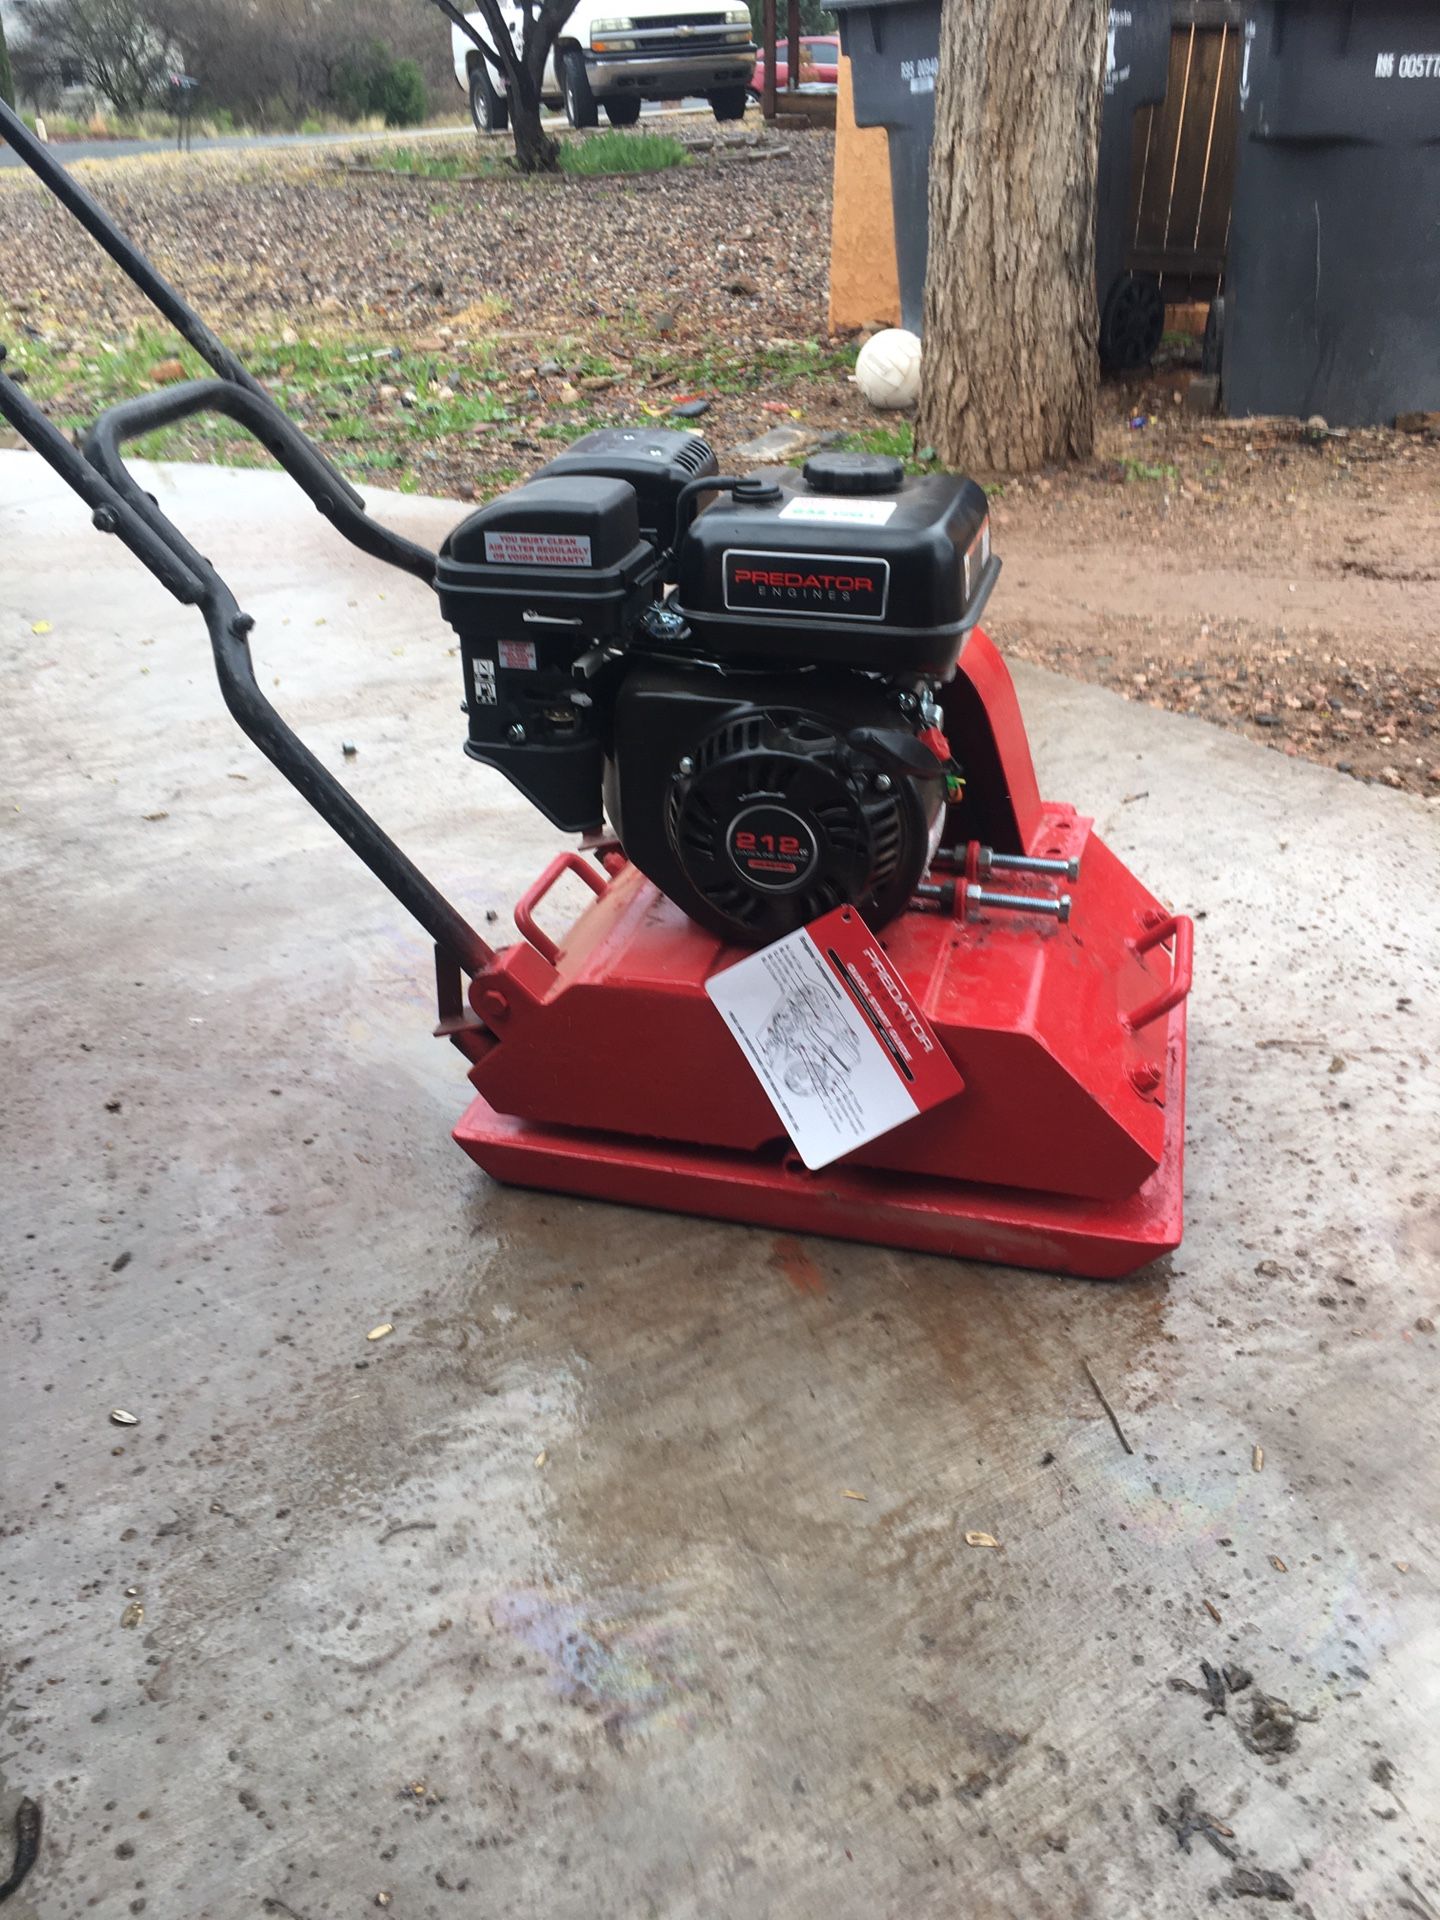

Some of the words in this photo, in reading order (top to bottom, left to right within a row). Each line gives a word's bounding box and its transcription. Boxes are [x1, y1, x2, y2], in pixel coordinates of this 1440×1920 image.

[488, 543, 503, 552] AIR
[505, 544, 535, 553] FILTER
[536, 546, 589, 555] REGULARLY
[500, 535, 518, 544] YOU
[519, 536, 545, 545] MUST
[547, 537, 577, 546] CLEAN
[493, 552, 505, 561] OR
[507, 553, 534, 562] VOIDS
[535, 555, 585, 565] WARRANTY
[734, 569, 875, 592] PREDATOR
[758, 585, 851, 601] ENGINES
[735, 831, 800, 855] 212
[862, 946, 934, 1054] PREDATOR
[847, 962, 873, 997] QUICK
[869, 996, 893, 1029] START
[888, 1027, 914, 1062] GUIDE
